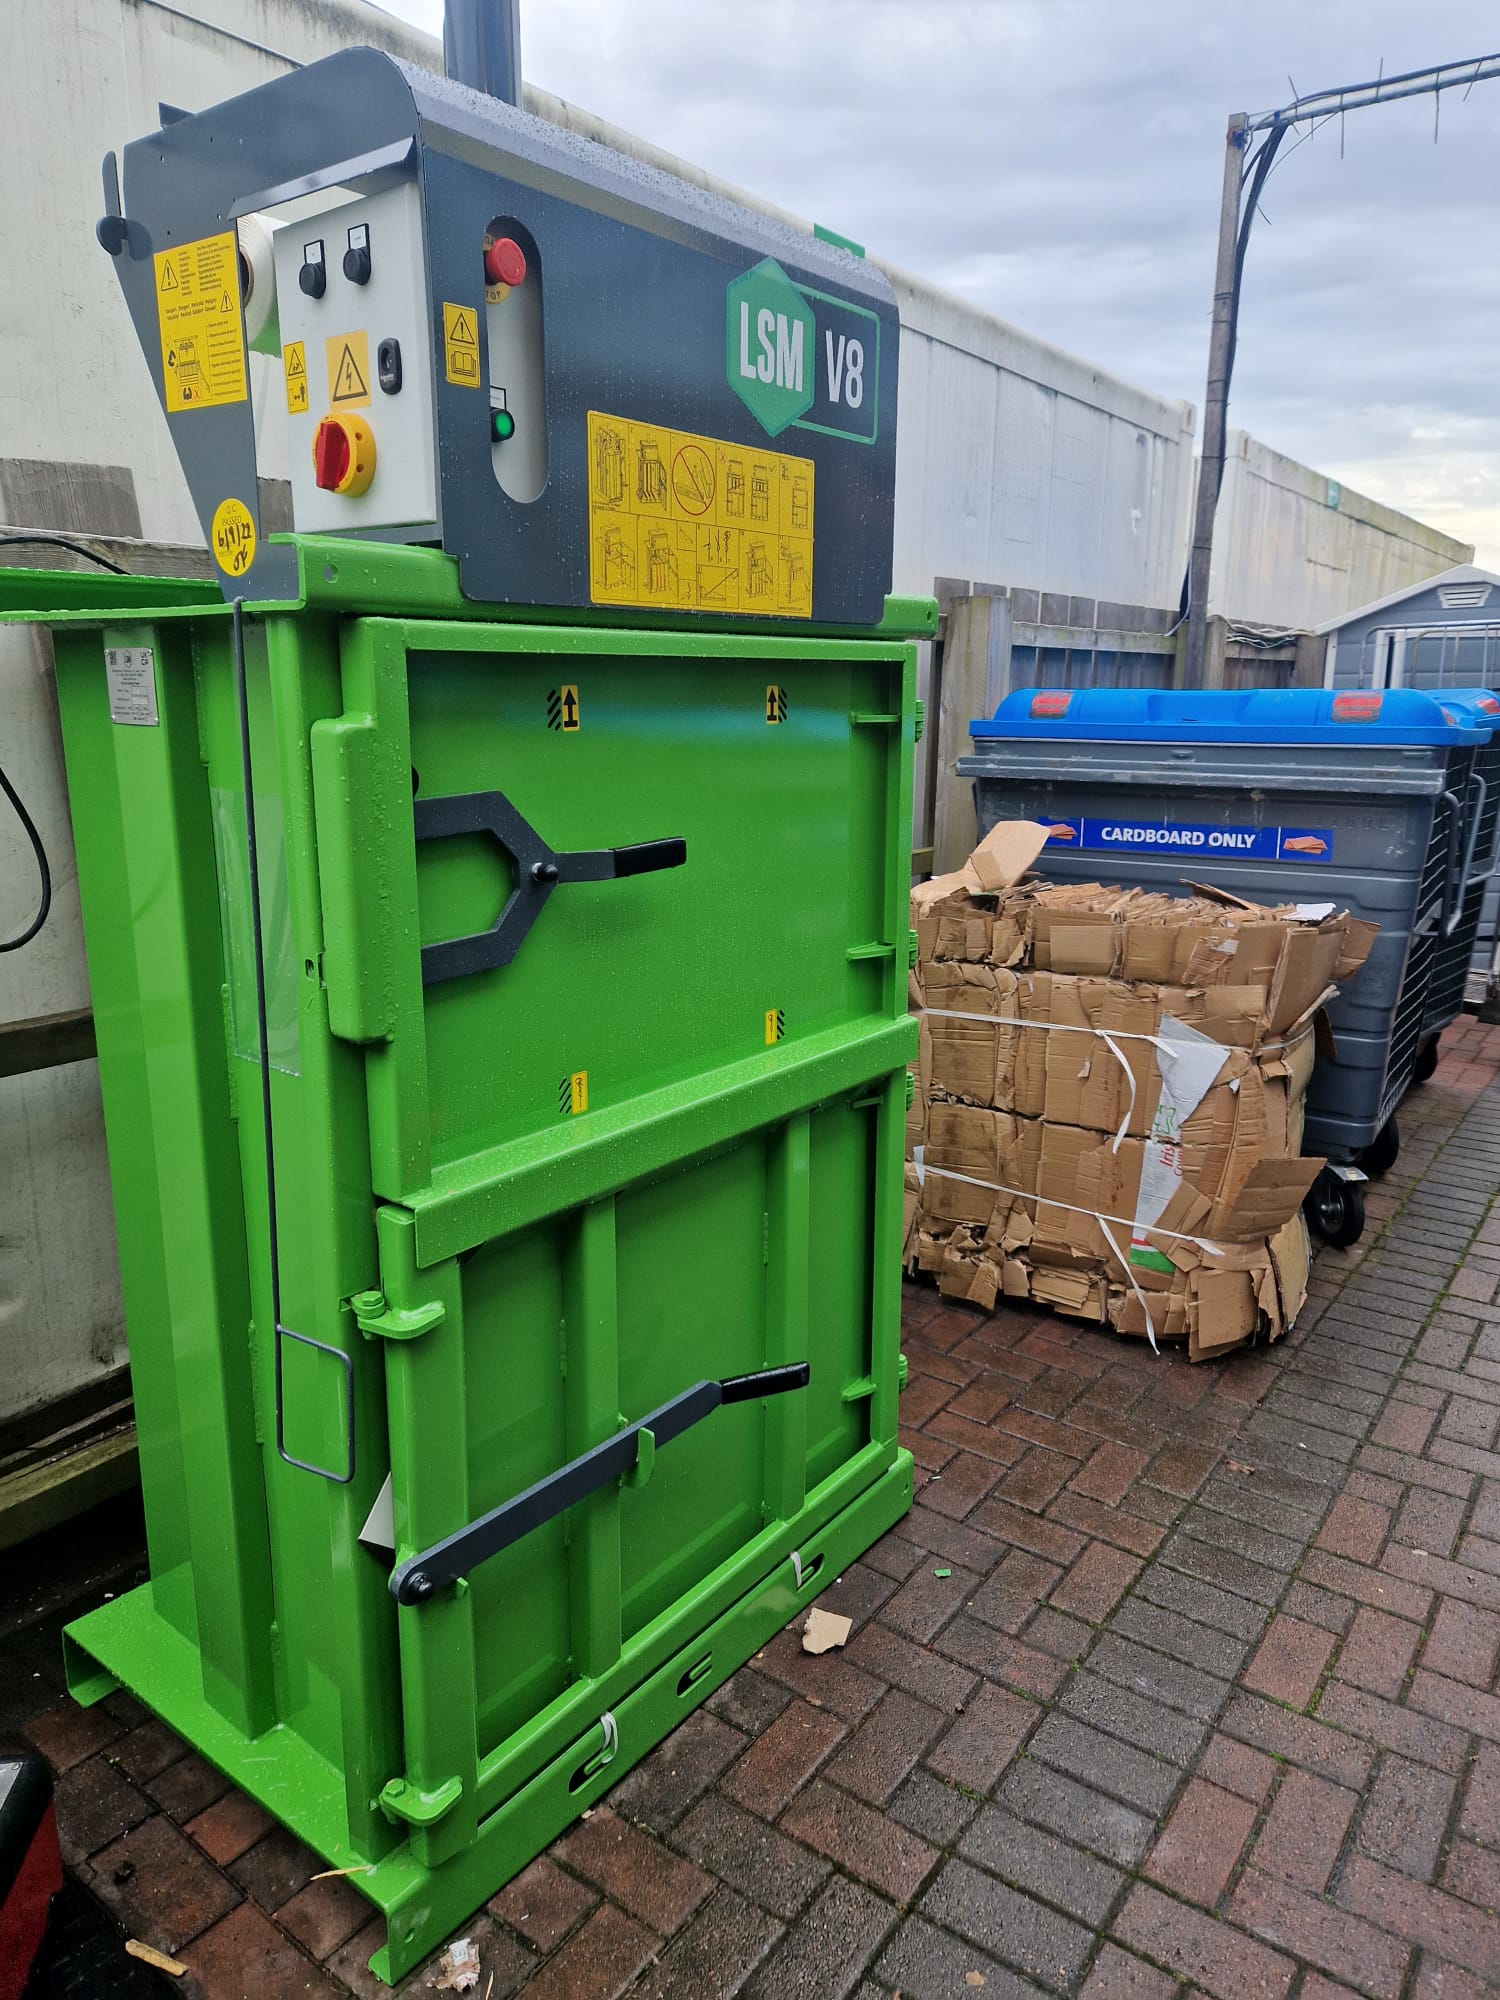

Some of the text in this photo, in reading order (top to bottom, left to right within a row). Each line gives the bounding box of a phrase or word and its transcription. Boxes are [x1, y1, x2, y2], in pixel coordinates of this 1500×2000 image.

[740, 301, 864, 409] LSM V8
[1101, 827, 1256, 849] CARDBOARD ONLY
